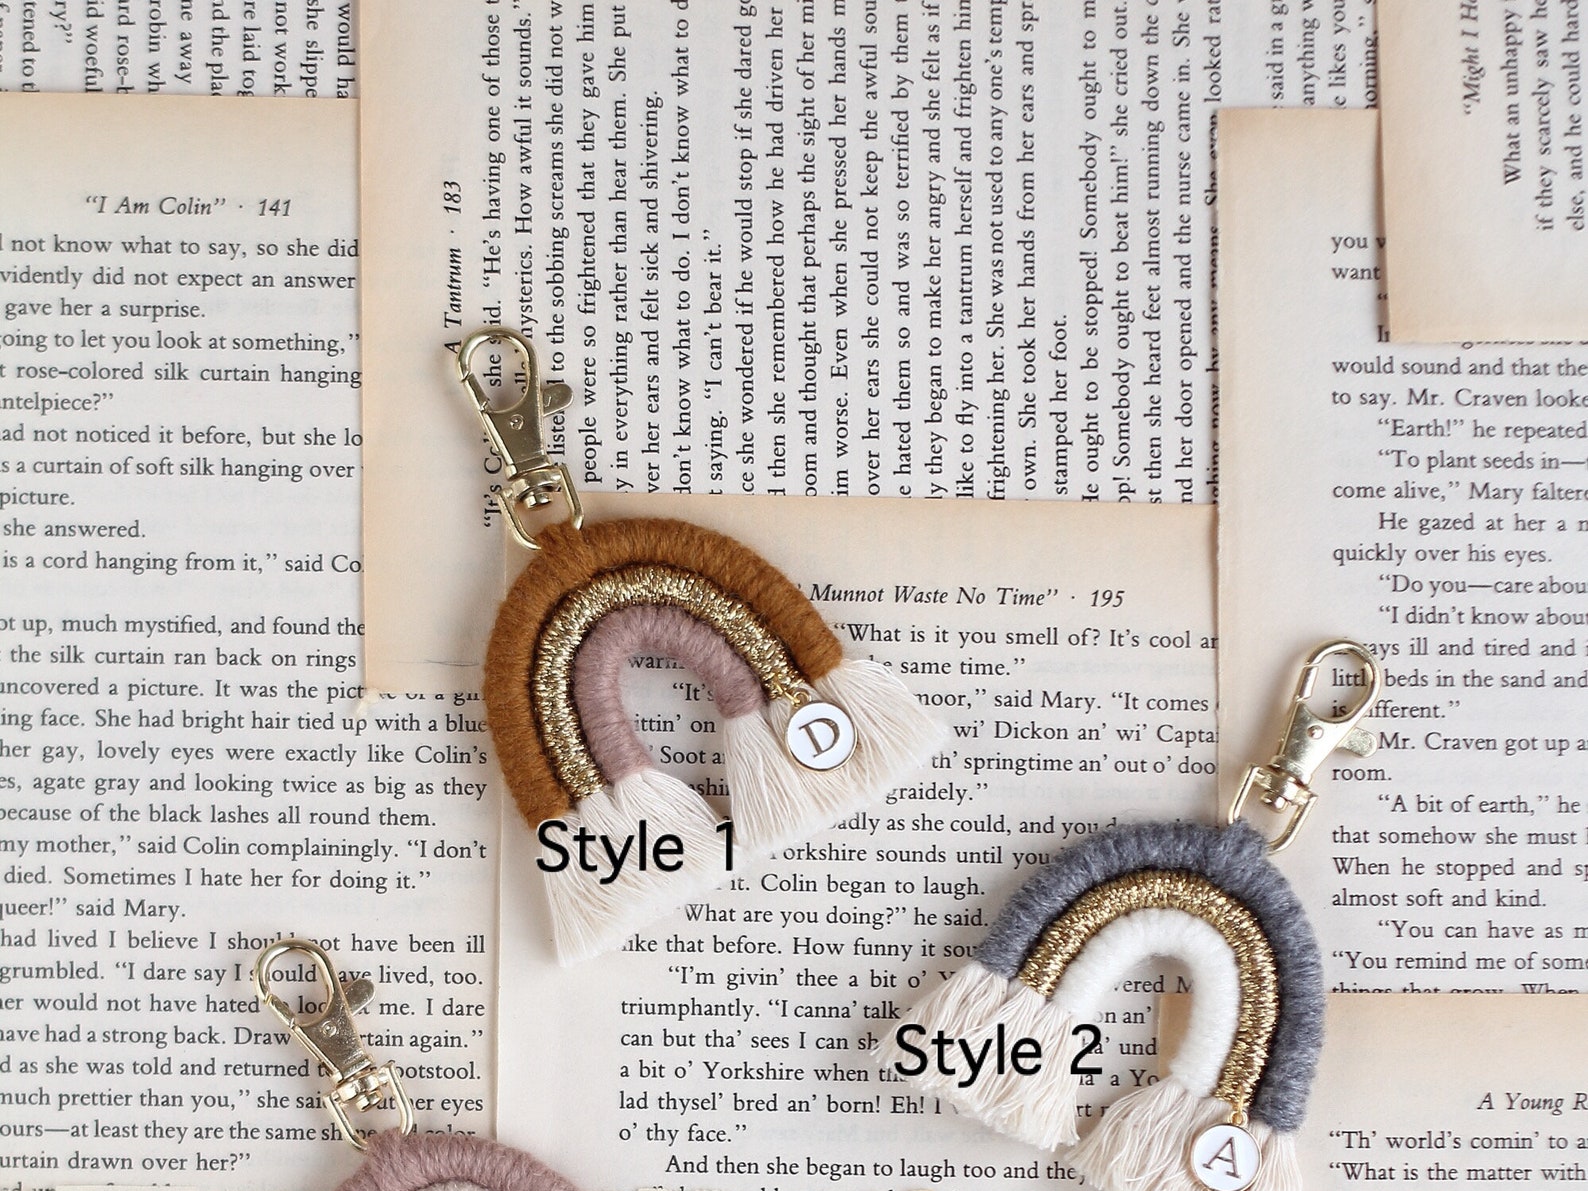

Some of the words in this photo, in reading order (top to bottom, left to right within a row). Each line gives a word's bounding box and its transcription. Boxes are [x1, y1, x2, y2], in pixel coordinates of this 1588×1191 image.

[575, 2, 594, 43] him
[1460, 0, 1478, 22] H
[1461, 30, 1479, 38] I
[1500, 12, 1523, 96] unhappy
[580, 52, 600, 98] gave
[1461, 47, 1486, 115] “Might
[1507, 103, 1520, 125] an
[574, 108, 600, 152] they
[1503, 133, 1521, 185] What
[574, 162, 595, 200] that
[86, 196, 108, 213] “I
[113, 196, 149, 214] Am
[157, 197, 226, 215] Colin”
[258, 199, 291, 216] 141
[443, 180, 462, 214] 183
[1331, 236, 1369, 254] you
[574, 210, 601, 316] frightened
[1332, 262, 1380, 281] want
[444, 247, 462, 328] Tantrum
[4, 302, 52, 321] gave
[58, 297, 93, 316] her
[100, 304, 112, 316] a
[119, 299, 205, 323] surprise.
[444, 339, 462, 354] A
[584, 325, 596, 347] so
[1048, 315, 1067, 361] foot.
[584, 356, 596, 405] were
[1049, 369, 1068, 403] her
[577, 416, 603, 485] people
[1049, 410, 1074, 495] stamped
[1332, 542, 1407, 566] quickly
[1414, 549, 1460, 562] over
[1467, 543, 1496, 562] his
[1503, 550, 1552, 568] eyes.
[808, 584, 885, 603] Munnot
[894, 585, 948, 604] Waste
[956, 587, 986, 604] No
[996, 587, 1058, 606] Time”
[1090, 589, 1125, 608] 195
[798, 717, 841, 758] D
[1331, 769, 1392, 782] room.
[4, 865, 52, 884] died.
[64, 866, 176, 886] Sometimes
[185, 868, 192, 886] I
[200, 868, 243, 886] hate
[249, 868, 283, 887] her
[291, 868, 322, 887] for
[329, 869, 388, 894] doing
[393, 871, 430, 889] it.”
[729, 874, 750, 891] it.
[759, 873, 818, 892] Colin
[826, 874, 887, 898] began
[894, 880, 915, 895] to
[921, 876, 985, 899] laugh.
[1329, 888, 1399, 906] almost
[1404, 888, 1444, 907] soft
[1450, 888, 1488, 907] and
[1494, 889, 1546, 907] kind.
[1475, 1092, 1495, 1110] A
[1504, 1092, 1565, 1116] Young
[618, 1121, 637, 1141] o’
[646, 1122, 679, 1147] thy
[687, 1123, 746, 1142] face.”
[1203, 1136, 1241, 1179] A
